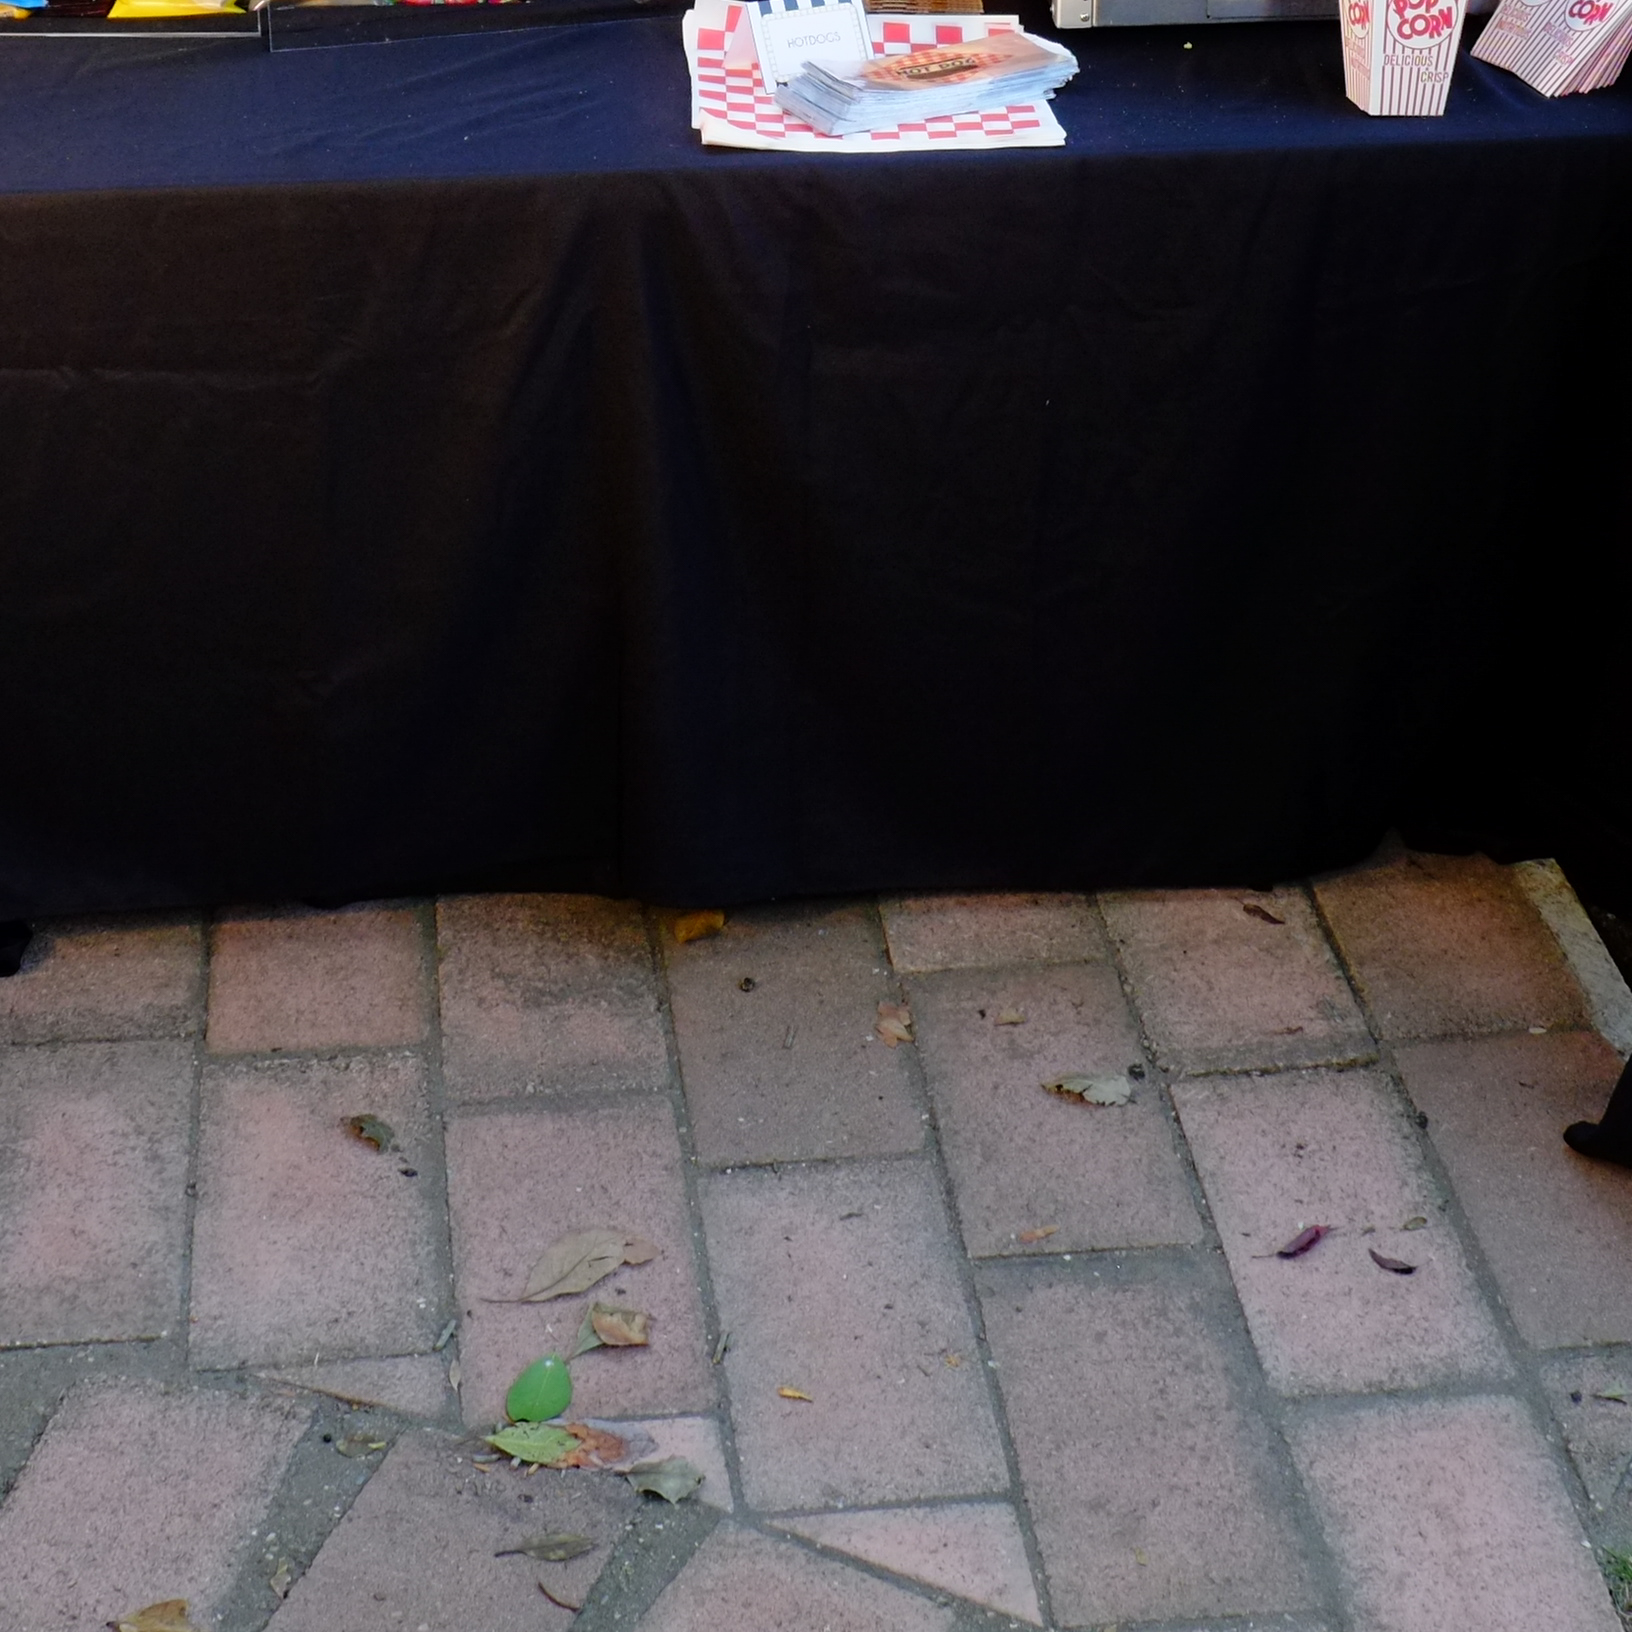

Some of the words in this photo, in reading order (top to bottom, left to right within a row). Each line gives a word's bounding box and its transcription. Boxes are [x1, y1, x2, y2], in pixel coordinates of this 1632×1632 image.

[1569, 0, 1614, 25] CORN
[1397, 6, 1453, 40] CORN
[787, 31, 841, 49] HOTDOGS
[1384, 54, 1434, 67] DELICIOUS
[1420, 72, 1449, 83] CRISP
